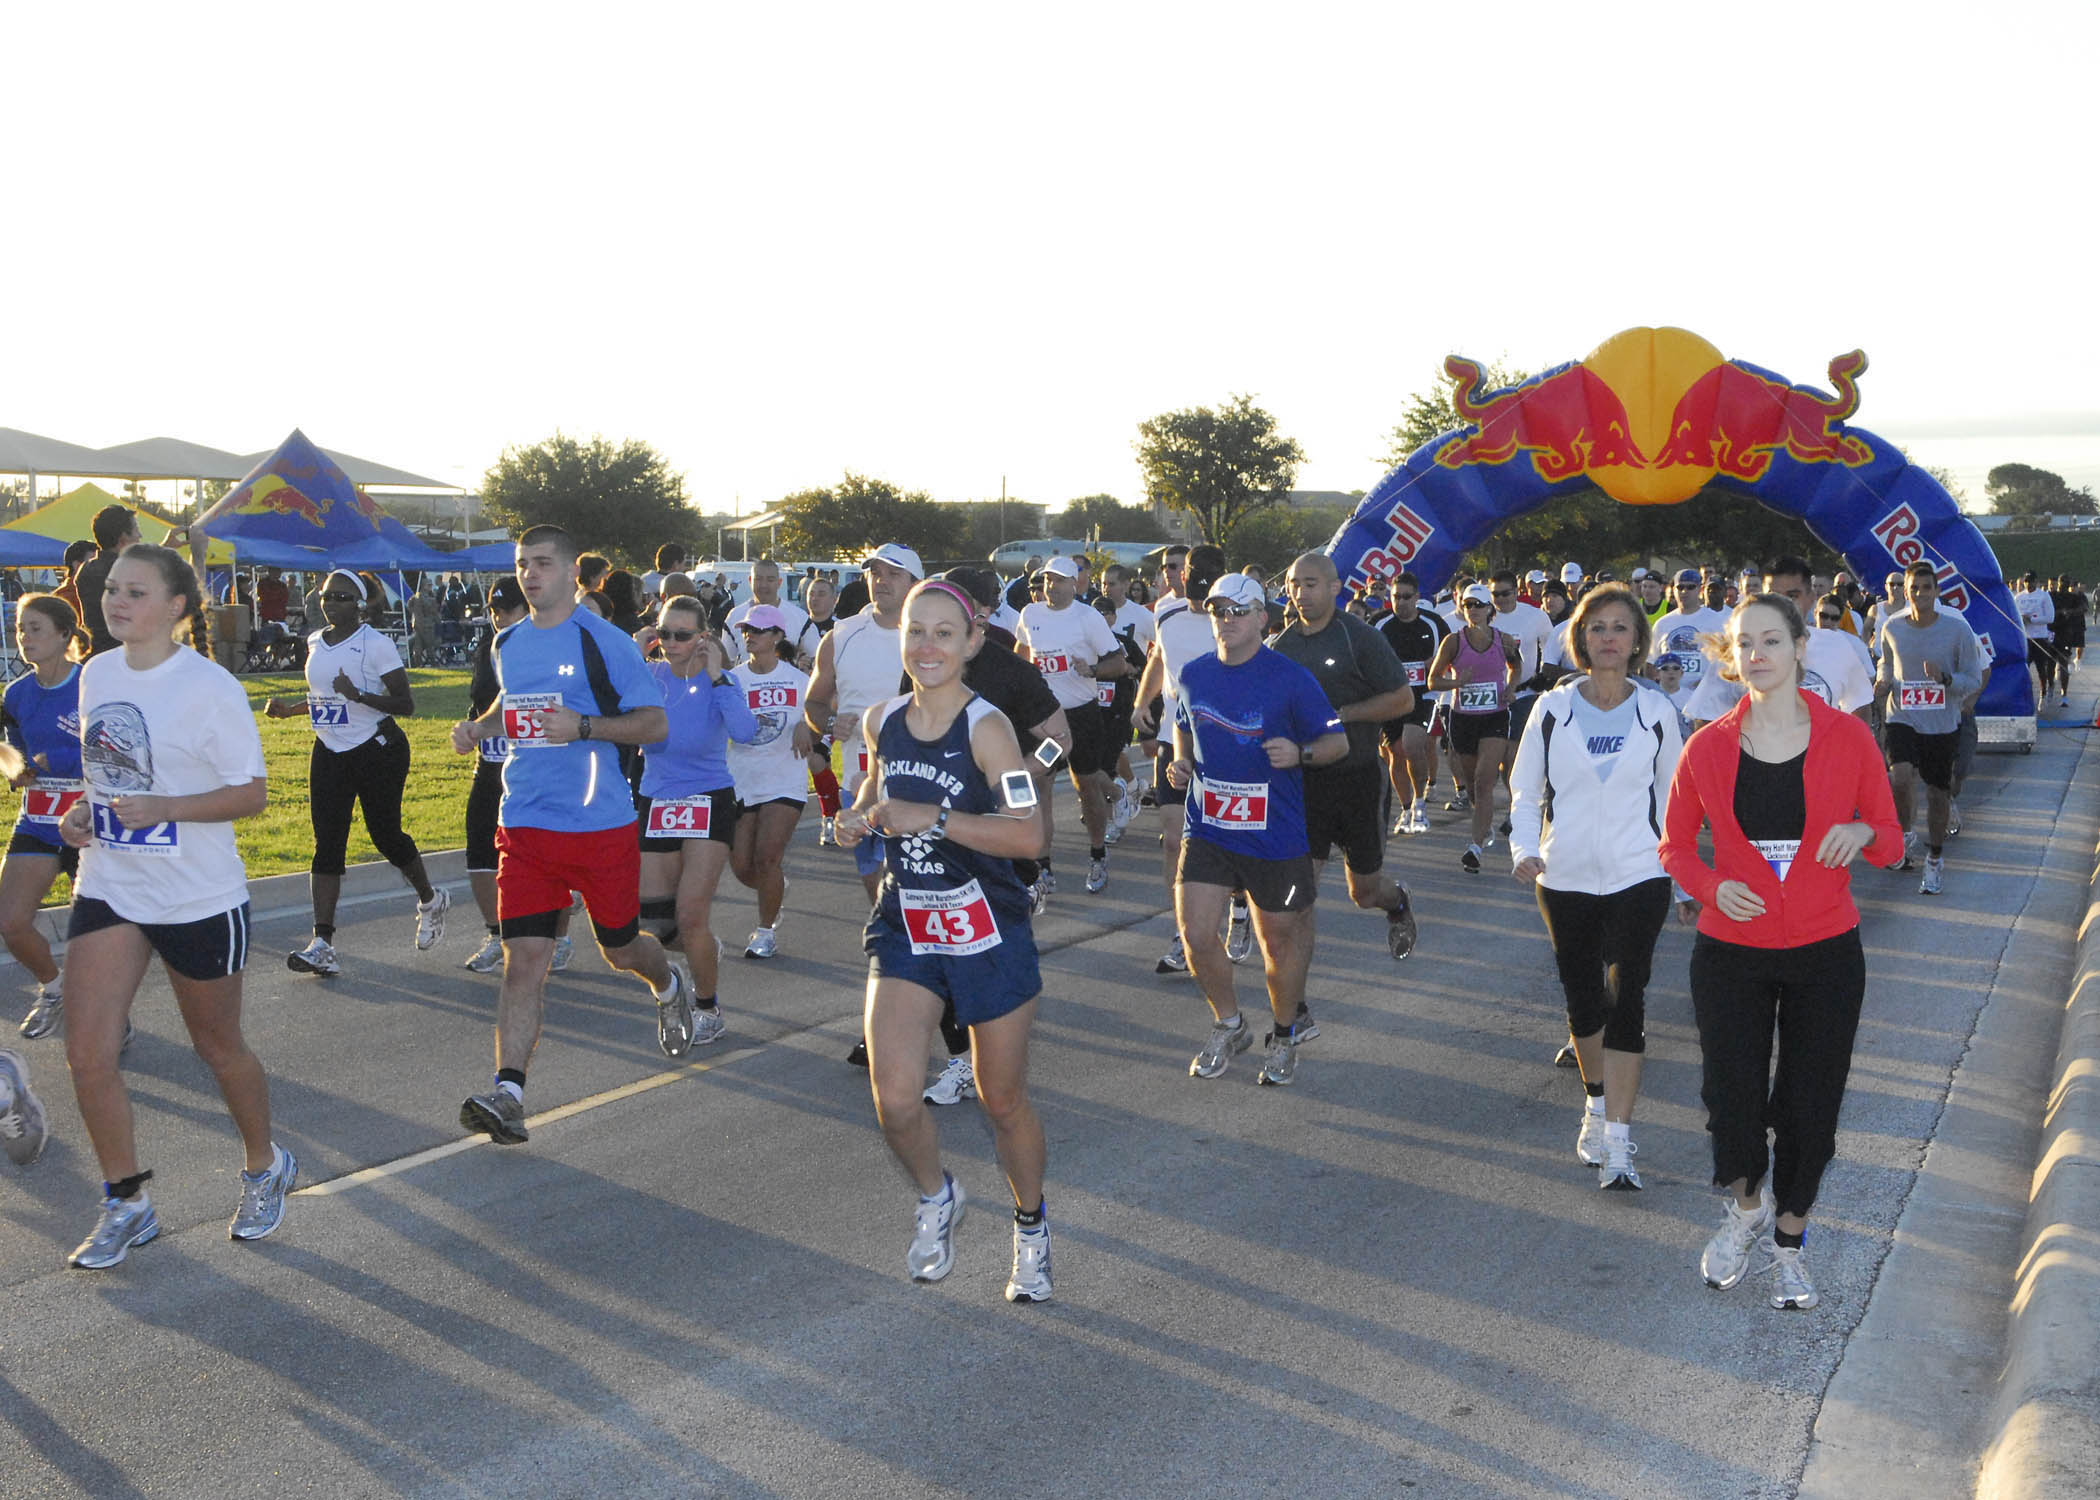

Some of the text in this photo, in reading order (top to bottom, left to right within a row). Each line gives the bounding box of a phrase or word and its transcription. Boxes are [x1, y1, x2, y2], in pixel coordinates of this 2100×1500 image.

[1356, 502, 1433, 590] Bull
[1680, 659, 1699, 672] 59
[758, 689, 787, 706] 80
[1463, 691, 1495, 706] 272
[1904, 689, 1940, 704] 417
[311, 705, 343, 724] 27
[1586, 736, 1625, 754] NIKE
[884, 760, 965, 797] ACKLAND AFB
[45, 791, 61, 815] 7
[1216, 795, 1252, 820] 74
[661, 807, 696, 829] 64
[901, 858, 945, 875] TXAS
[925, 909, 975, 944] 43
